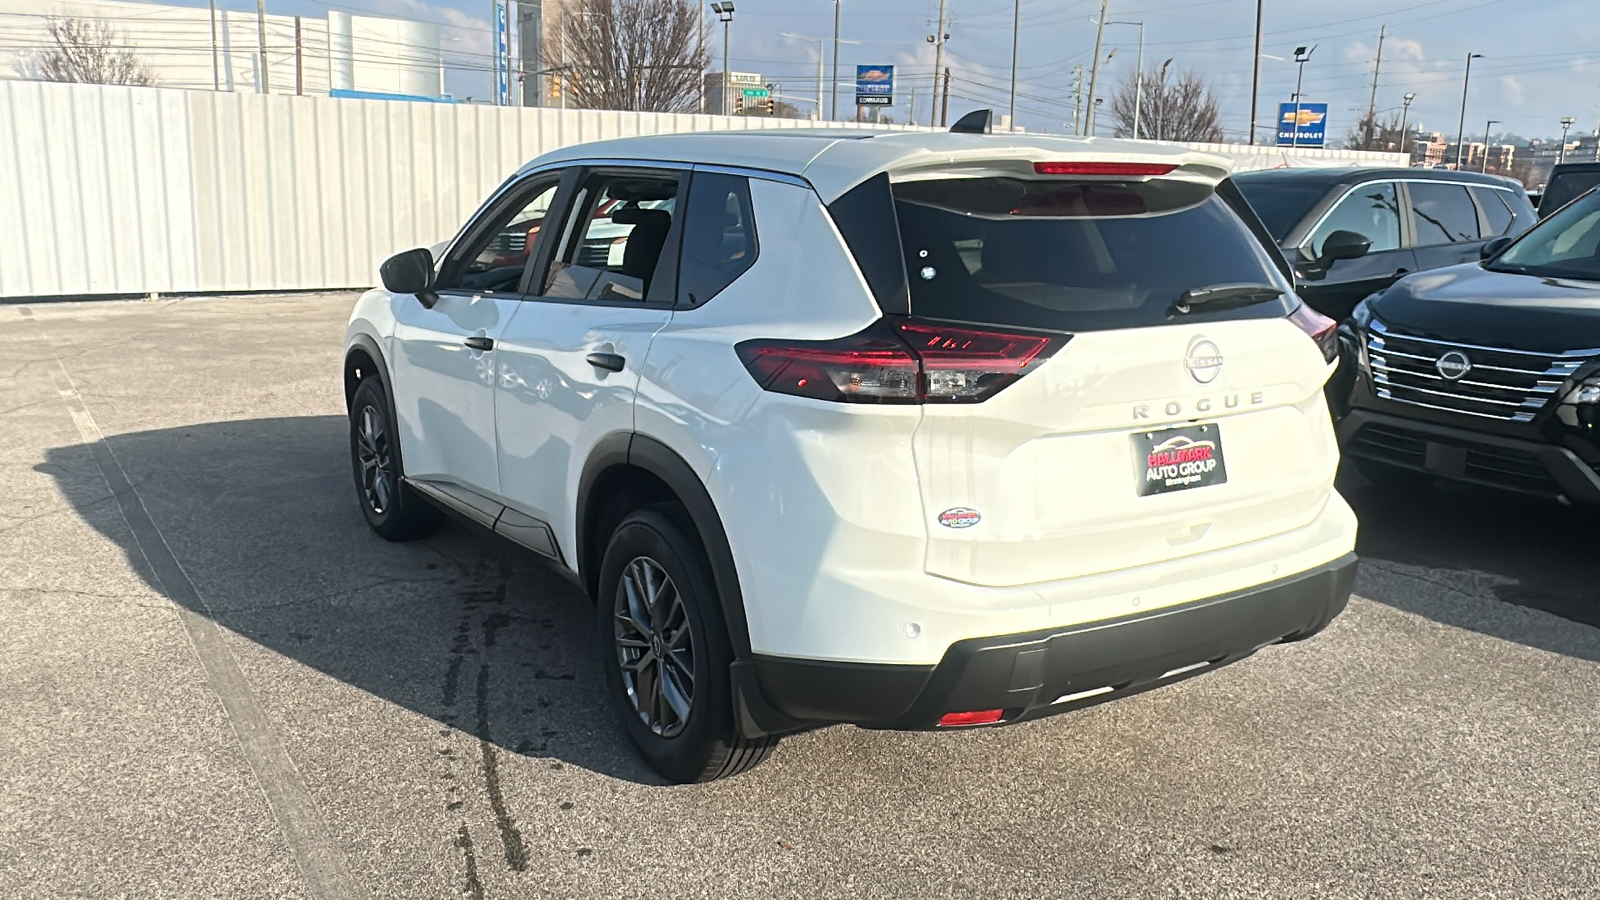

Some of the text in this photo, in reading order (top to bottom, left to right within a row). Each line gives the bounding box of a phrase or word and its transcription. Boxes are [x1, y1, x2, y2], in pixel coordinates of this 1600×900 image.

[1133, 392, 1263, 419] ROGUE
[1147, 446, 1212, 467] HALLMARK
[1146, 459, 1217, 481] AUTO GROUP
